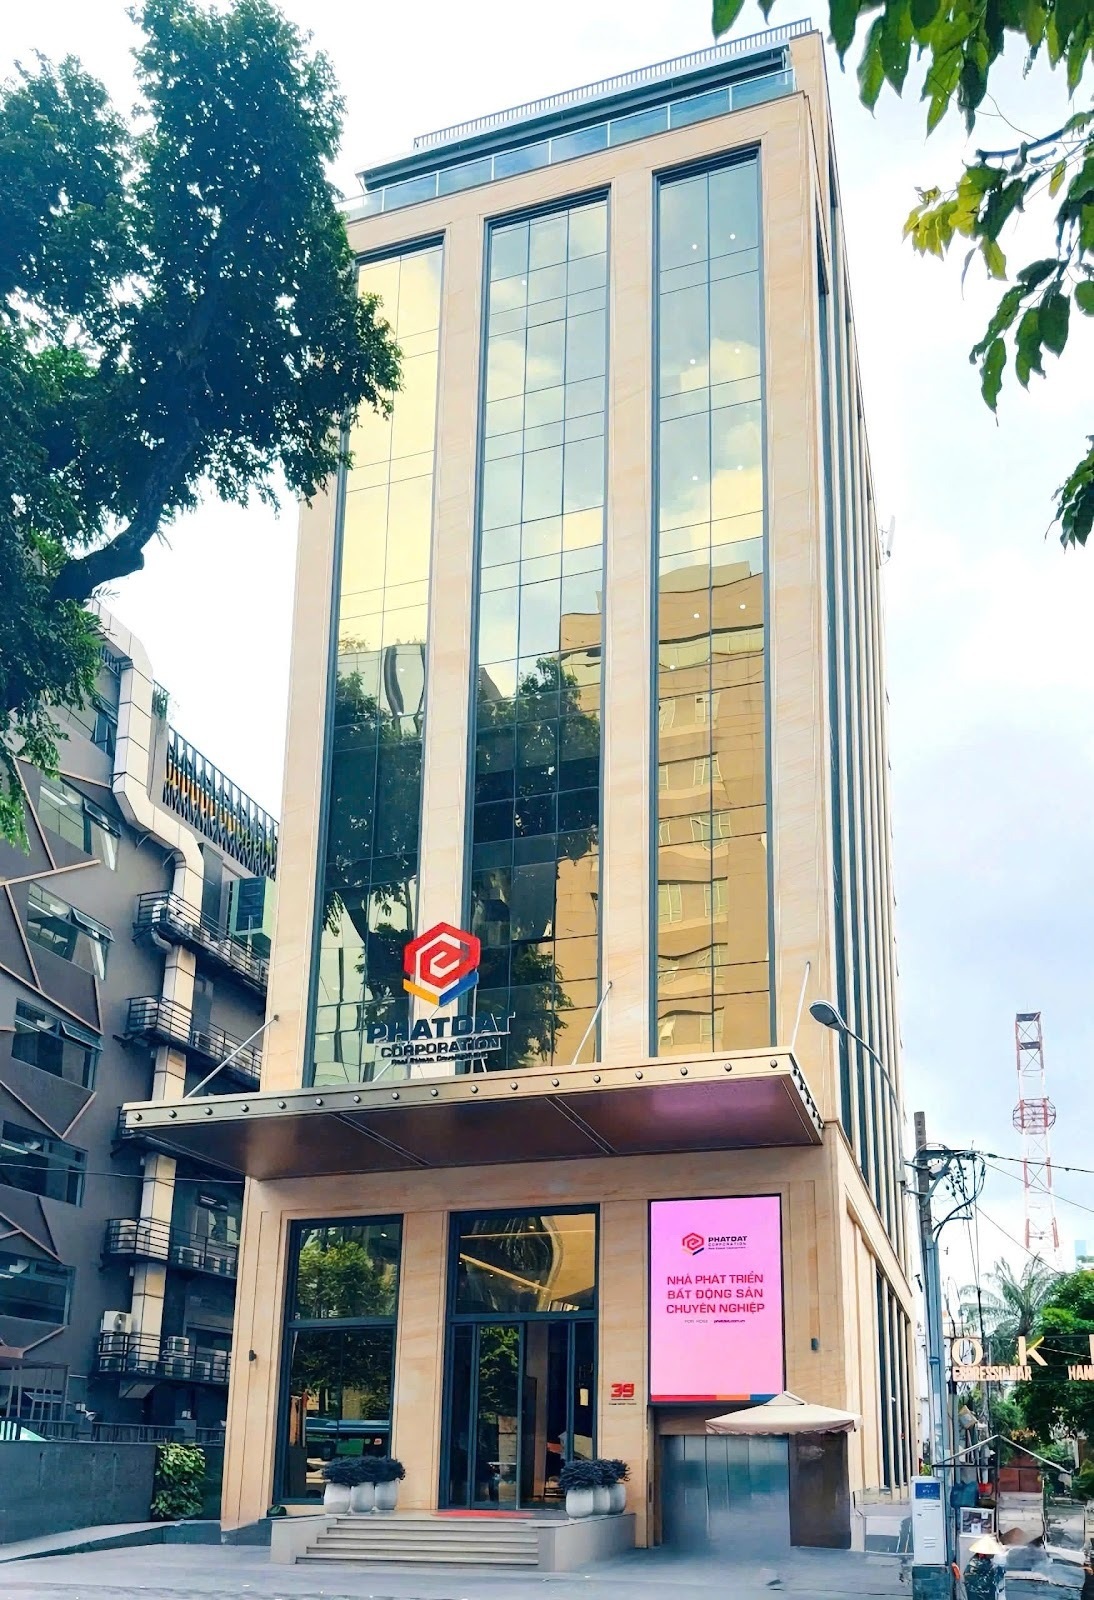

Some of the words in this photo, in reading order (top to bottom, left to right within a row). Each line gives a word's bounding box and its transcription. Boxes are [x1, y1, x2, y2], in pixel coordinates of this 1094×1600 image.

[367, 1012, 515, 1043] PHATDAT
[381, 1036, 500, 1057] CORPORATION
[667, 1274, 692, 1285] NHÀ
[695, 1273, 726, 1284] PHÁT
[729, 1271, 763, 1284] TRIỂN
[668, 1288, 692, 1299] BẤT
[696, 1288, 732, 1300] ĐỘNG
[736, 1286, 763, 1298] SẢN
[667, 1303, 715, 1313] CHUYÊN
[720, 1302, 765, 1314] NGHIỆP
[611, 1383, 635, 1398] 39
